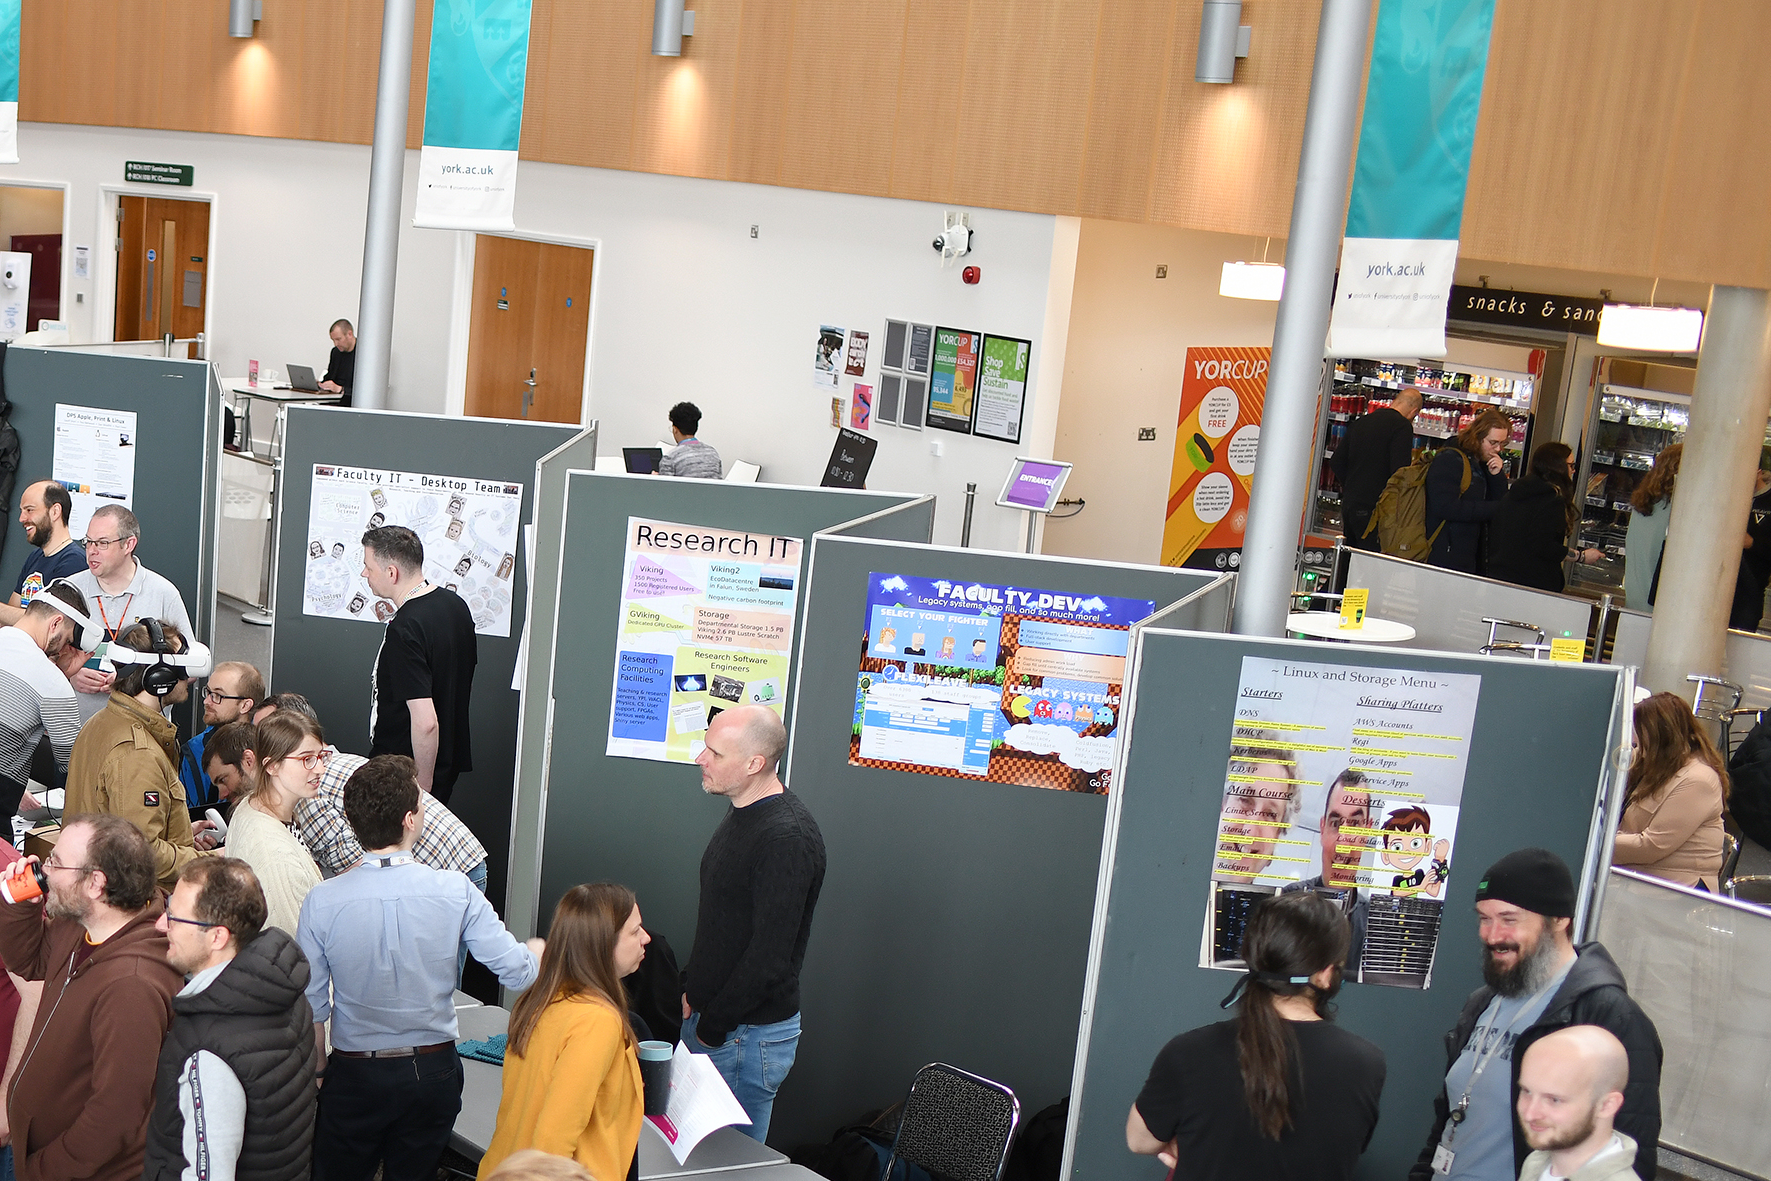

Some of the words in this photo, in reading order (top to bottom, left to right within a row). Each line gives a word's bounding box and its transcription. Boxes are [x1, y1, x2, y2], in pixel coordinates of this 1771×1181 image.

[441, 164, 494, 175] york.ac.uk
[1366, 261, 1426, 279] york.ac.uk
[1467, 294, 1527, 314] snacks
[1541, 300, 1556, 318] &
[939, 333, 968, 347] YORCUP
[985, 356, 1004, 368] Shop
[984, 366, 1001, 378] Save
[1194, 360, 1268, 380] YORCUP
[982, 377, 1009, 390] Sustain
[77, 413, 93, 421] Apple,
[94, 415, 106, 423] Print
[1208, 420, 1227, 428] FREE
[336, 468, 382, 484] Faculty
[389, 473, 402, 484] IT
[421, 476, 468, 493] Desktop
[474, 481, 501, 494] Team
[1019, 474, 1053, 487] ENTRANCE
[636, 525, 759, 557] Research
[769, 537, 795, 559] IT
[466, 549, 492, 570] Biology
[640, 565, 664, 575] Viking
[710, 565, 740, 575] Viking2
[710, 576, 754, 585] EcoDatacentre
[708, 594, 735, 602] Negative
[736, 596, 757, 604] carbon
[757, 598, 784, 606] footprint
[937, 583, 1033, 608] FACULTY
[1038, 594, 1083, 612] DEV
[918, 596, 949, 607] Legacy
[950, 599, 984, 611] systems,
[986, 604, 1003, 613] gap
[1019, 605, 1036, 615] and
[1050, 609, 1073, 619] much
[1075, 613, 1100, 622] more!
[629, 610, 660, 621] GViking
[698, 610, 730, 620] Storage
[881, 608, 915, 618] SELECT
[919, 612, 945, 621] YOUR
[948, 615, 989, 626] FIGHTER
[698, 619, 738, 628] Departmental
[740, 623, 764, 632] Storage
[1065, 626, 1094, 636] WHAT
[757, 632, 780, 640] Scratch
[622, 654, 658, 665] Research
[694, 651, 731, 661] Research
[733, 654, 768, 665] Software
[1063, 652, 1085, 661] WHY
[621, 663, 664, 676] Computing
[710, 662, 750, 673] Engineers
[620, 673, 654, 683] Facilities
[894, 671, 968, 688] FLEXILEAVE
[1283, 666, 1319, 679] Linux
[1322, 671, 1347, 681] and
[1349, 671, 1397, 688] Storage
[1400, 676, 1437, 689] Menu
[617, 687, 639, 695] Teaching
[1009, 684, 1059, 698] LEGACY
[1063, 691, 1121, 704] SYSTEMS
[1241, 687, 1283, 699] Starters
[1356, 696, 1398, 710] Sharing
[1400, 699, 1443, 712] Platters
[1239, 709, 1259, 717] DNS
[1352, 718, 1376, 727] AWS
[1376, 720, 1414, 729] Accounts
[1235, 728, 1264, 736] DHCP
[1352, 737, 1370, 746] Regi
[1348, 755, 1375, 767] Google
[1375, 758, 1397, 768] Apps
[1230, 765, 1258, 773] LDAP
[1089, 779, 1101, 787] Go
[1387, 777, 1409, 788] Apps
[1228, 785, 1256, 796] Main
[1258, 788, 1293, 799] Course
[1341, 795, 1385, 808] Desserts
[1221, 825, 1251, 835] Storage
[1336, 835, 1358, 843] Load
[1219, 843, 1244, 852] Email
[1334, 854, 1361, 862] Puppet
[1217, 862, 1250, 872] Backups
[1330, 872, 1374, 884] Monitoring
